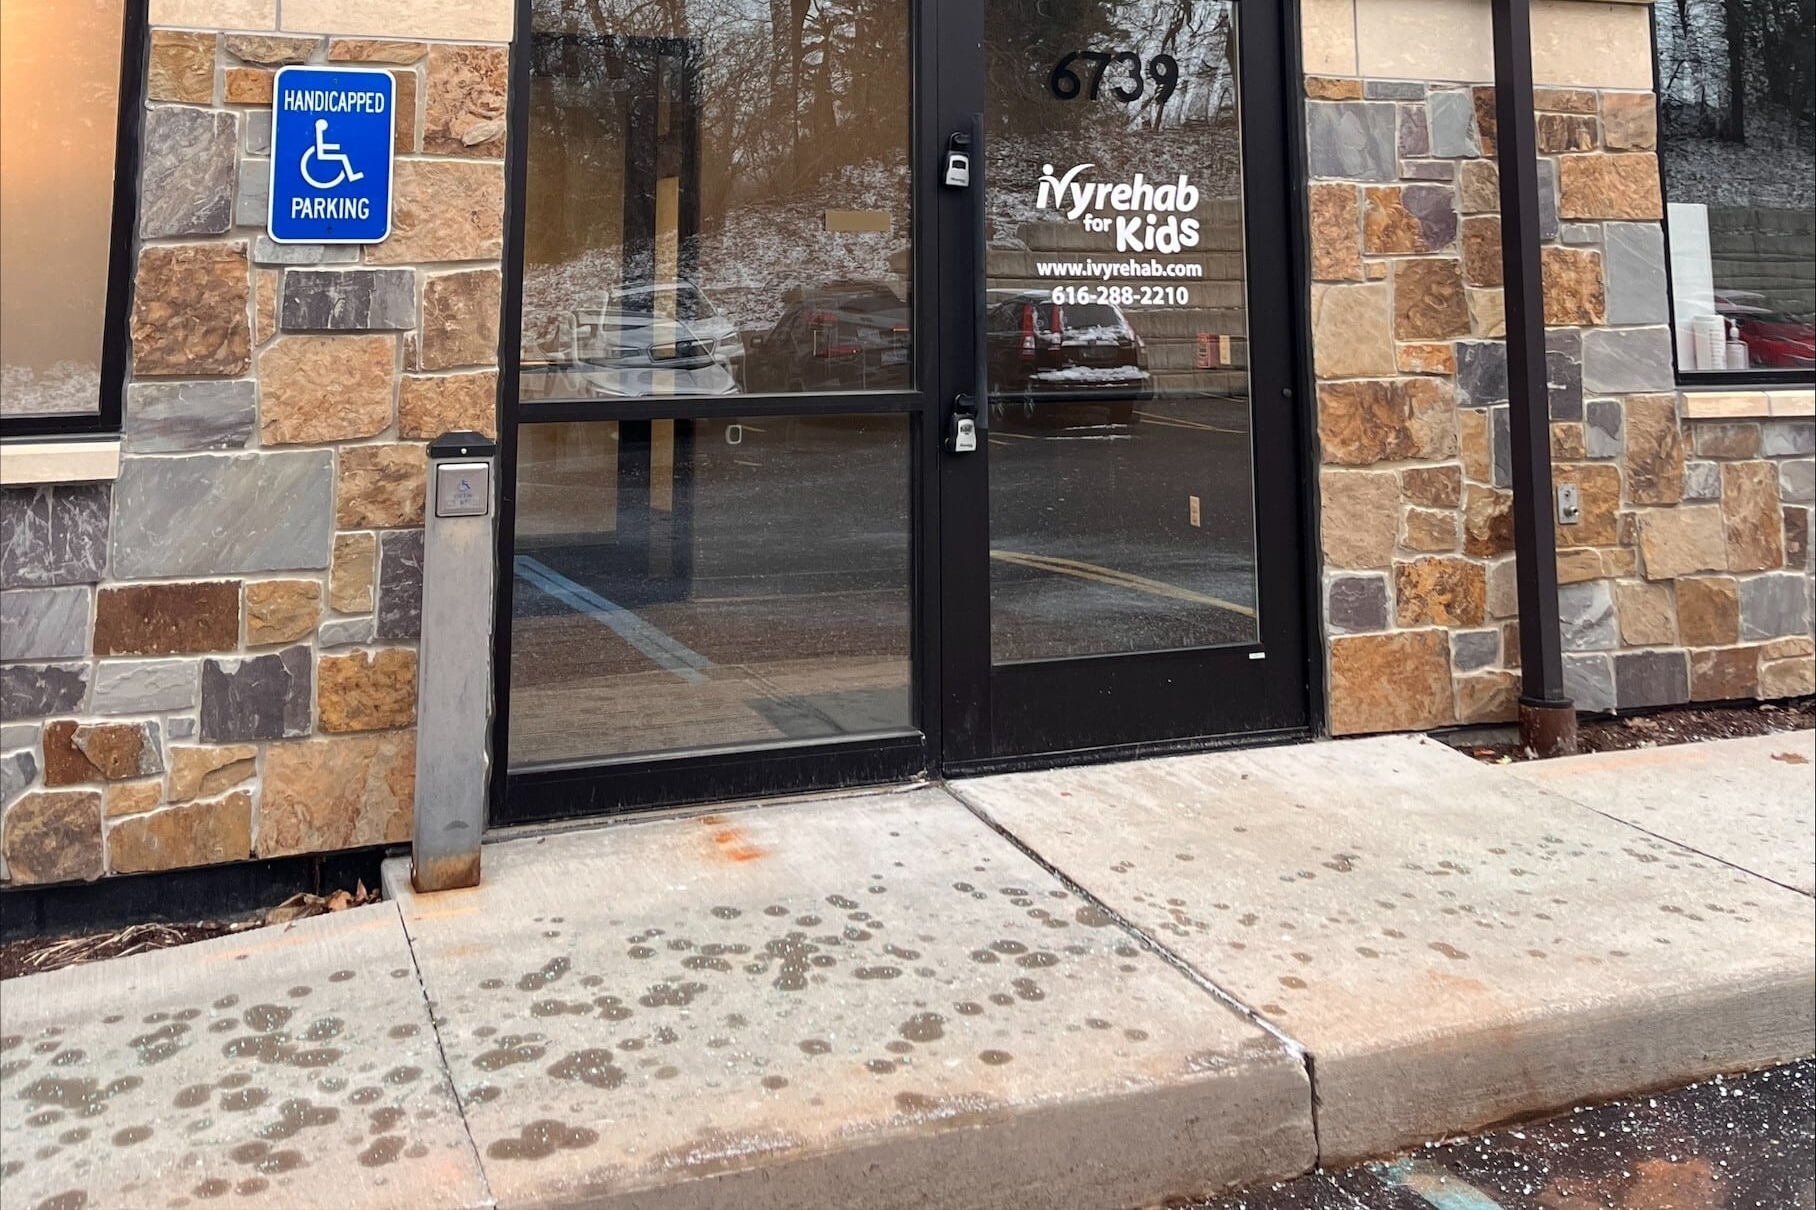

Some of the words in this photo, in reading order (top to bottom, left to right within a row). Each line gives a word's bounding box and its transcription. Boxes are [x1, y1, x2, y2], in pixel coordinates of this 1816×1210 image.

[1051, 51, 1178, 103] 6739
[284, 89, 385, 113] HANDICAPPED
[1036, 163, 1199, 220] ivyrehab
[291, 197, 369, 220] PARKING
[1083, 213, 1113, 232] for
[1116, 213, 1200, 254] Kids
[1036, 259, 1202, 280] www.ivyrehab.com
[1051, 286, 1189, 306] 616-288-2210
